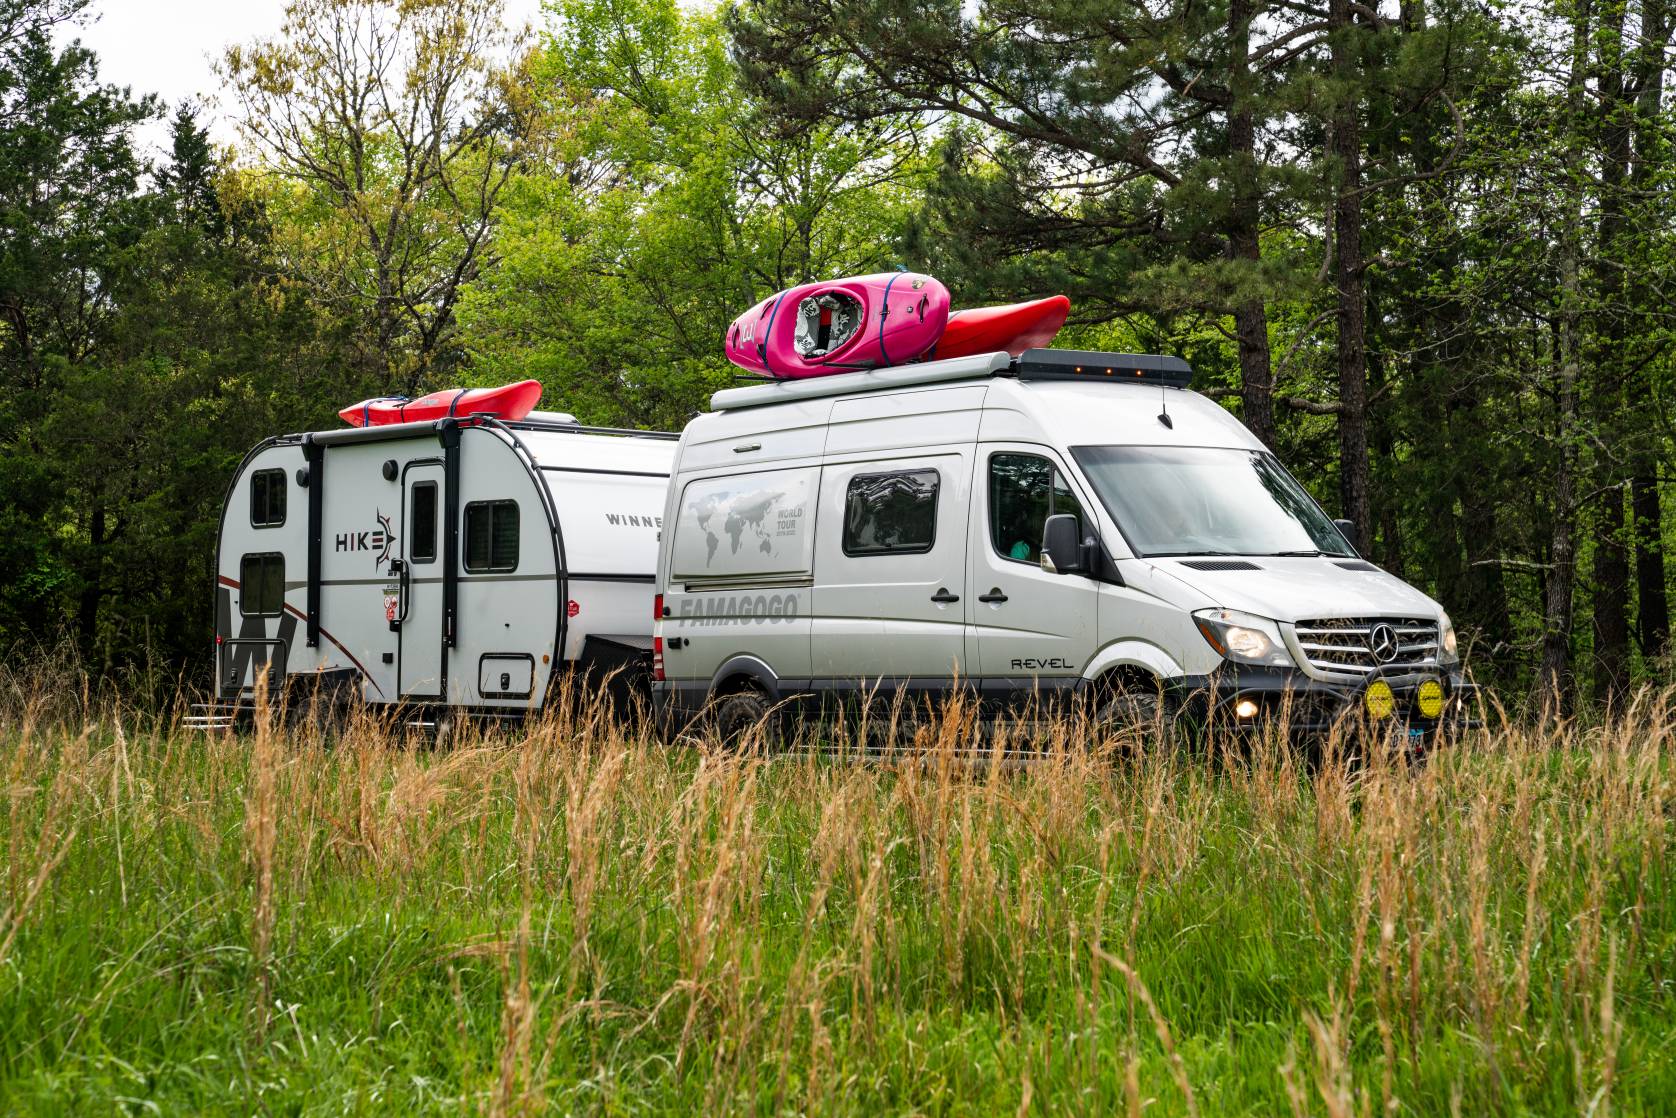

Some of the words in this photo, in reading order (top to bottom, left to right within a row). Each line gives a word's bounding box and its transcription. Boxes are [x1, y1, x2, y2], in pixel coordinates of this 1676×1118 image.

[778, 508, 803, 518] WORLD
[605, 513, 662, 528] WINNE
[777, 520, 796, 530] TOUR
[336, 531, 384, 552] HIKE
[679, 594, 798, 627] FAMAGOGO
[1011, 658, 1075, 670] REVEL
